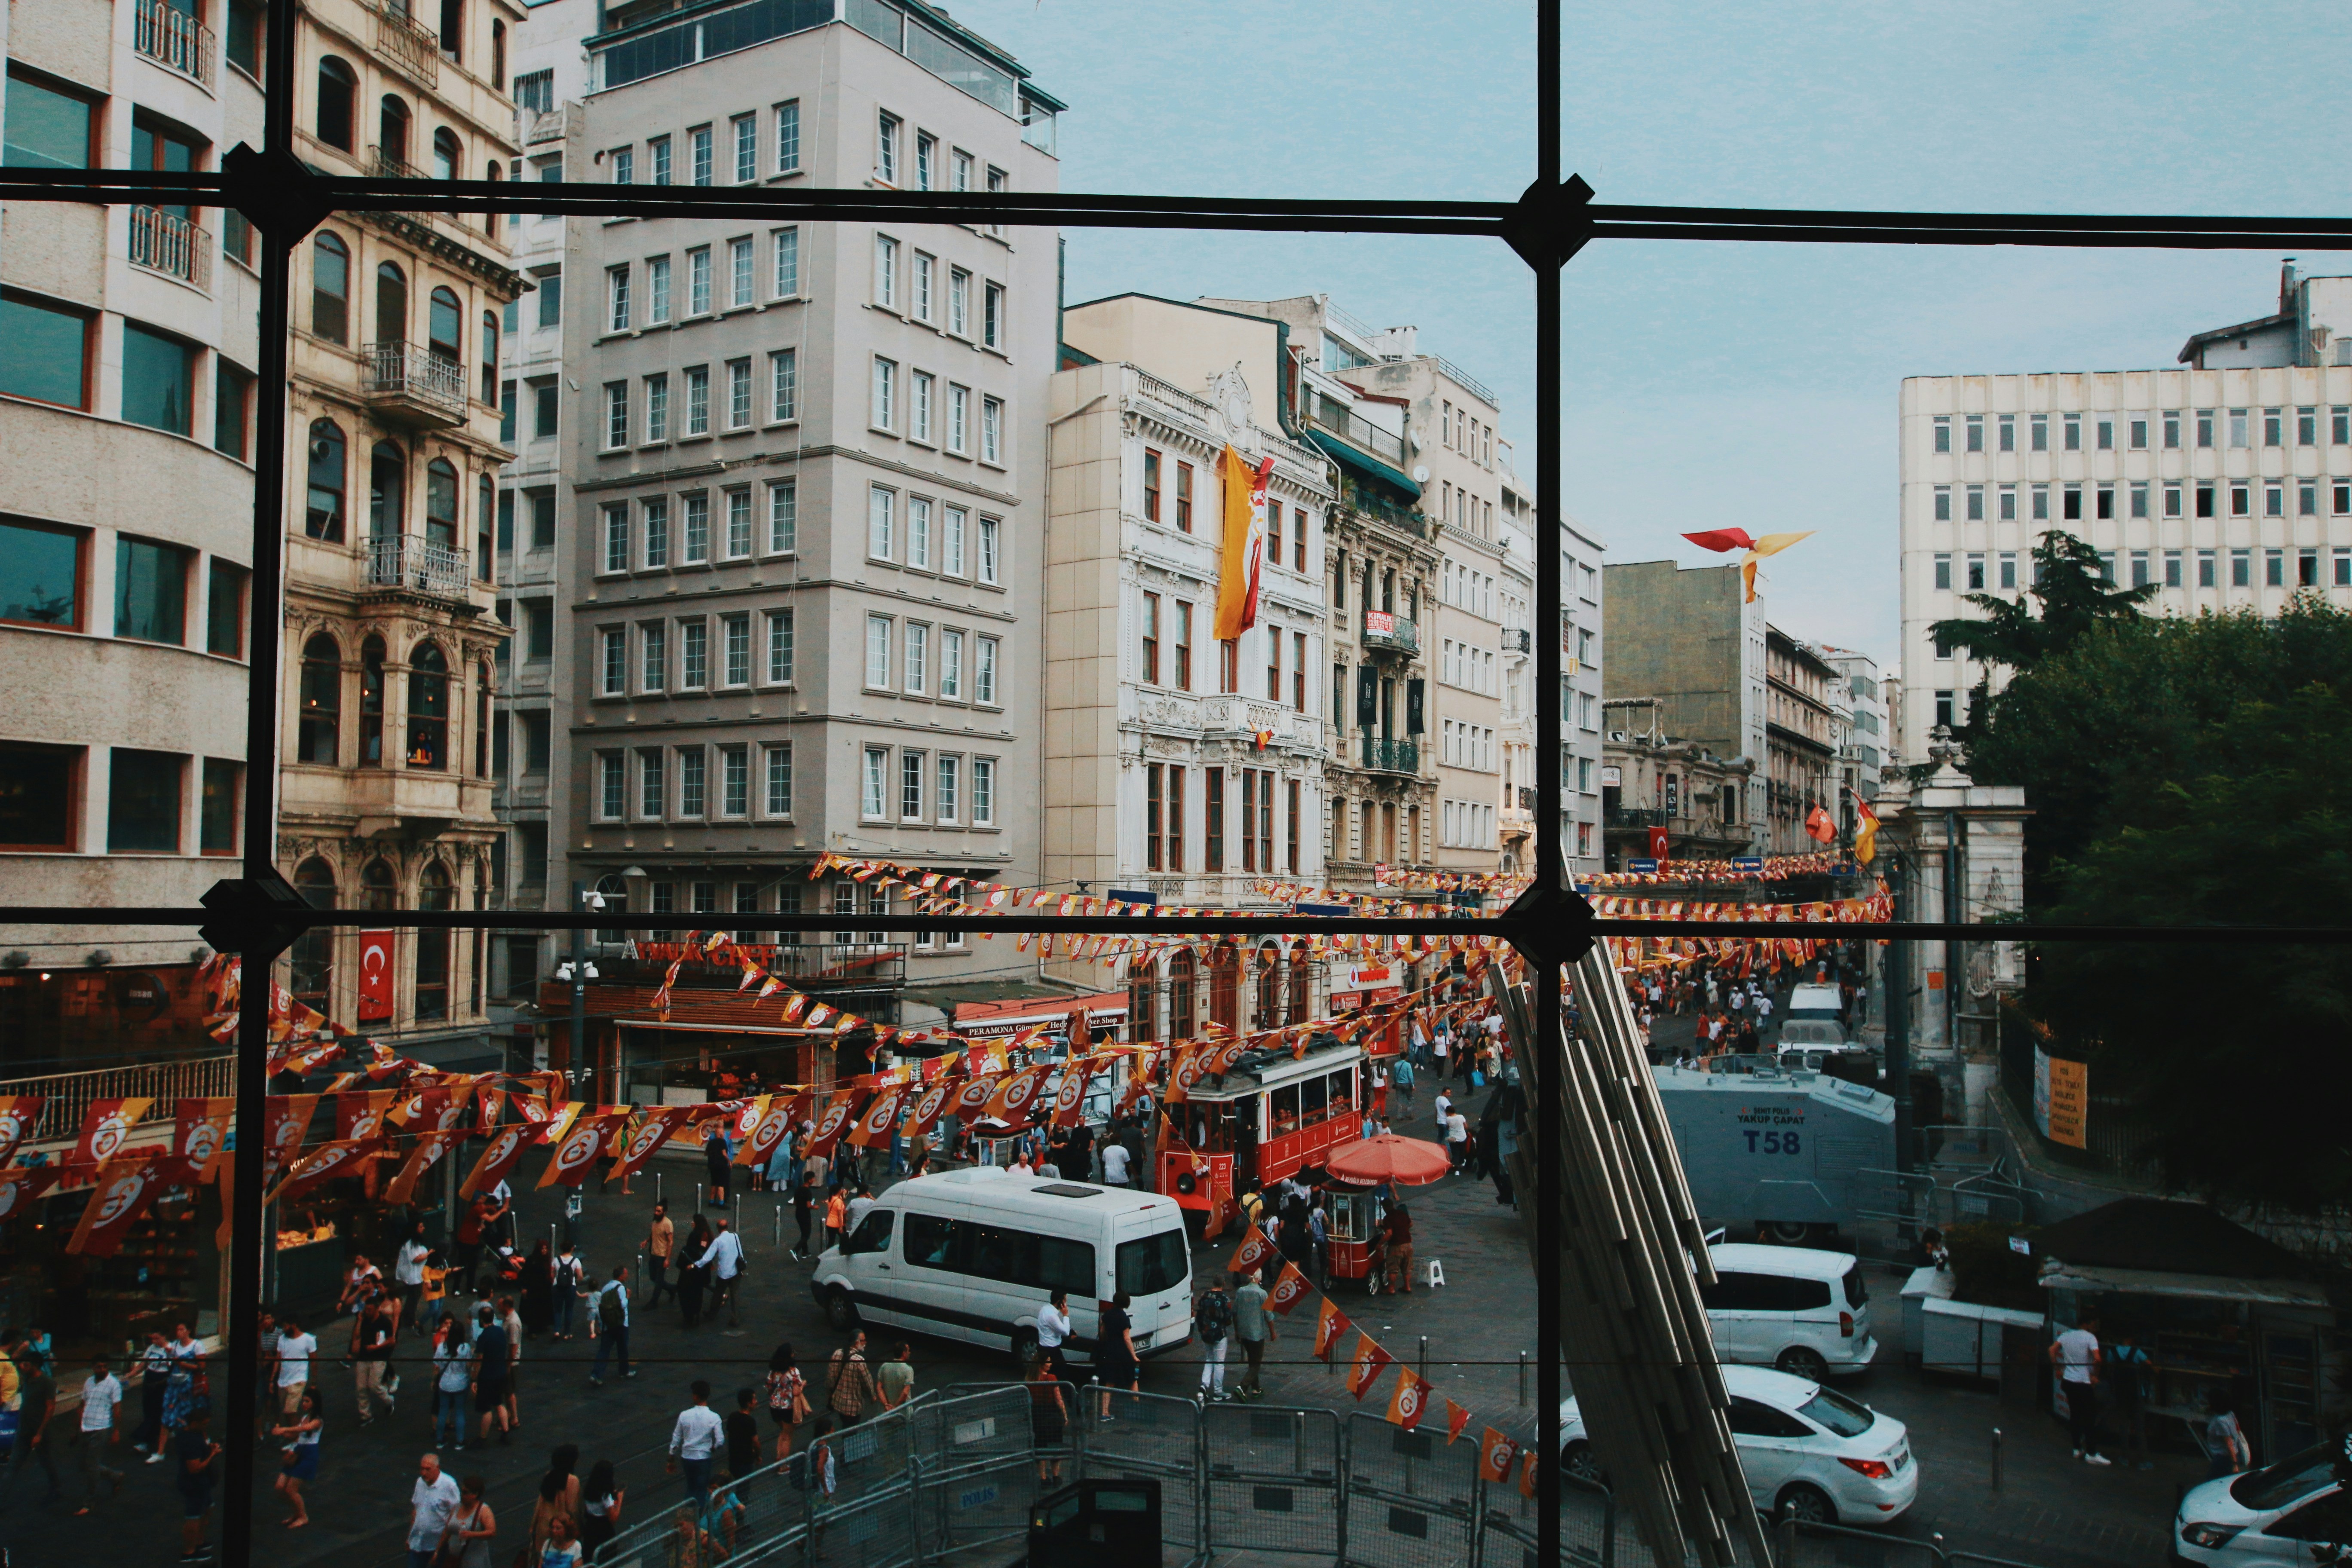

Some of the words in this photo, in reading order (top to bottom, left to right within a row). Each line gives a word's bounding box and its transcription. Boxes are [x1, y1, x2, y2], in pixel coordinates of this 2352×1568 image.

[969, 1025, 1014, 1036] PERAMONA
[1102, 1017, 1118, 1025] Shop
[1737, 1115, 1770, 1124] YAKUP
[1773, 1115, 1805, 1126] ÇAPAT
[1743, 1130, 1801, 1155] T58
